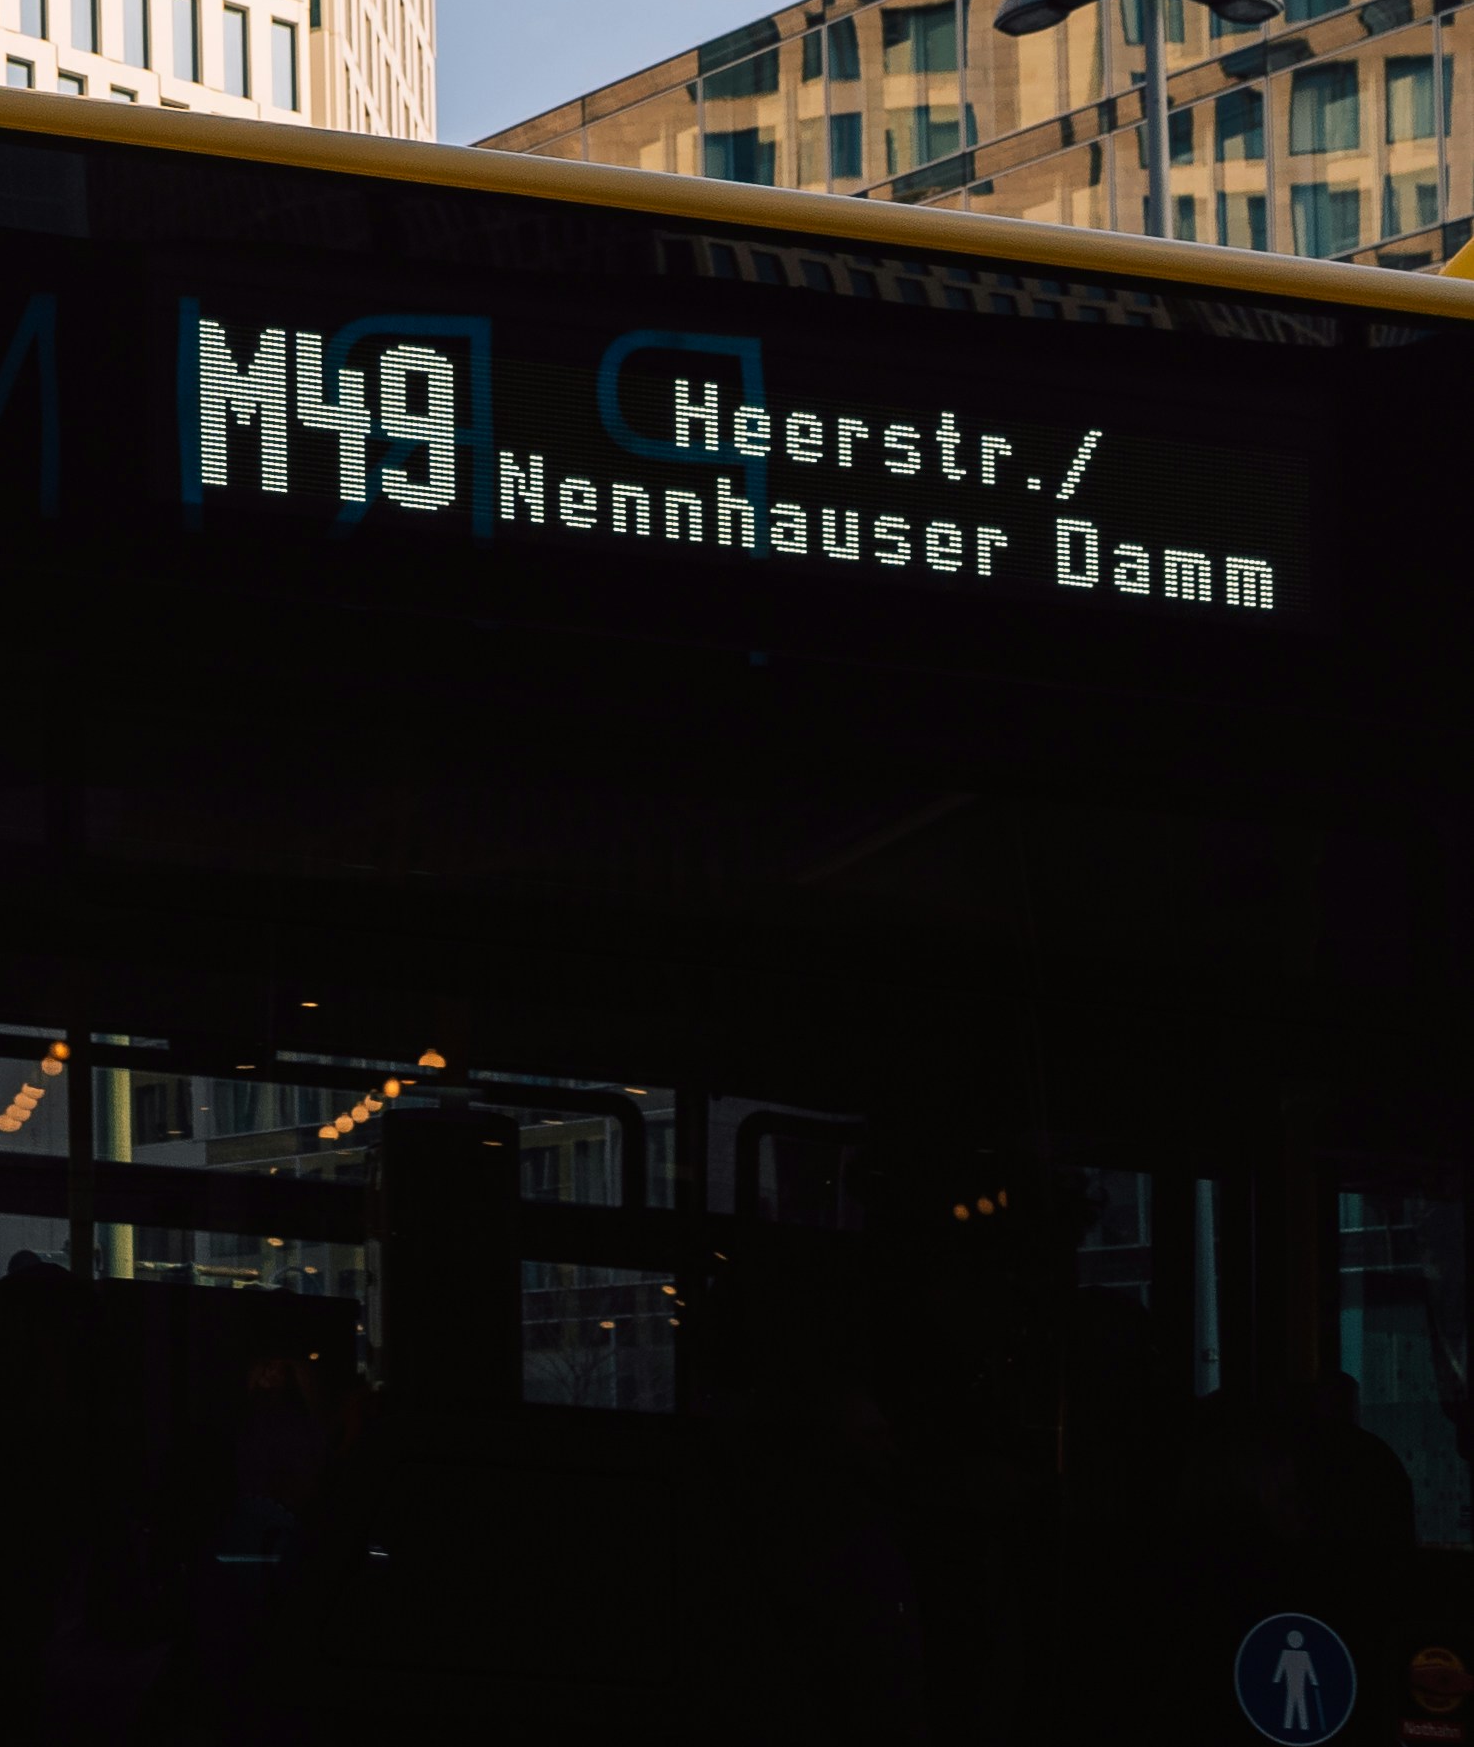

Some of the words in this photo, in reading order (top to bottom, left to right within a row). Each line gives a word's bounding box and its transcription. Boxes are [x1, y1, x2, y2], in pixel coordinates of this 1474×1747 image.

[198, 318, 456, 511] M49
[673, 377, 1104, 502] Heerstr./
[498, 451, 1009, 578] Nennhauser
[1055, 517, 1275, 611] Damm
